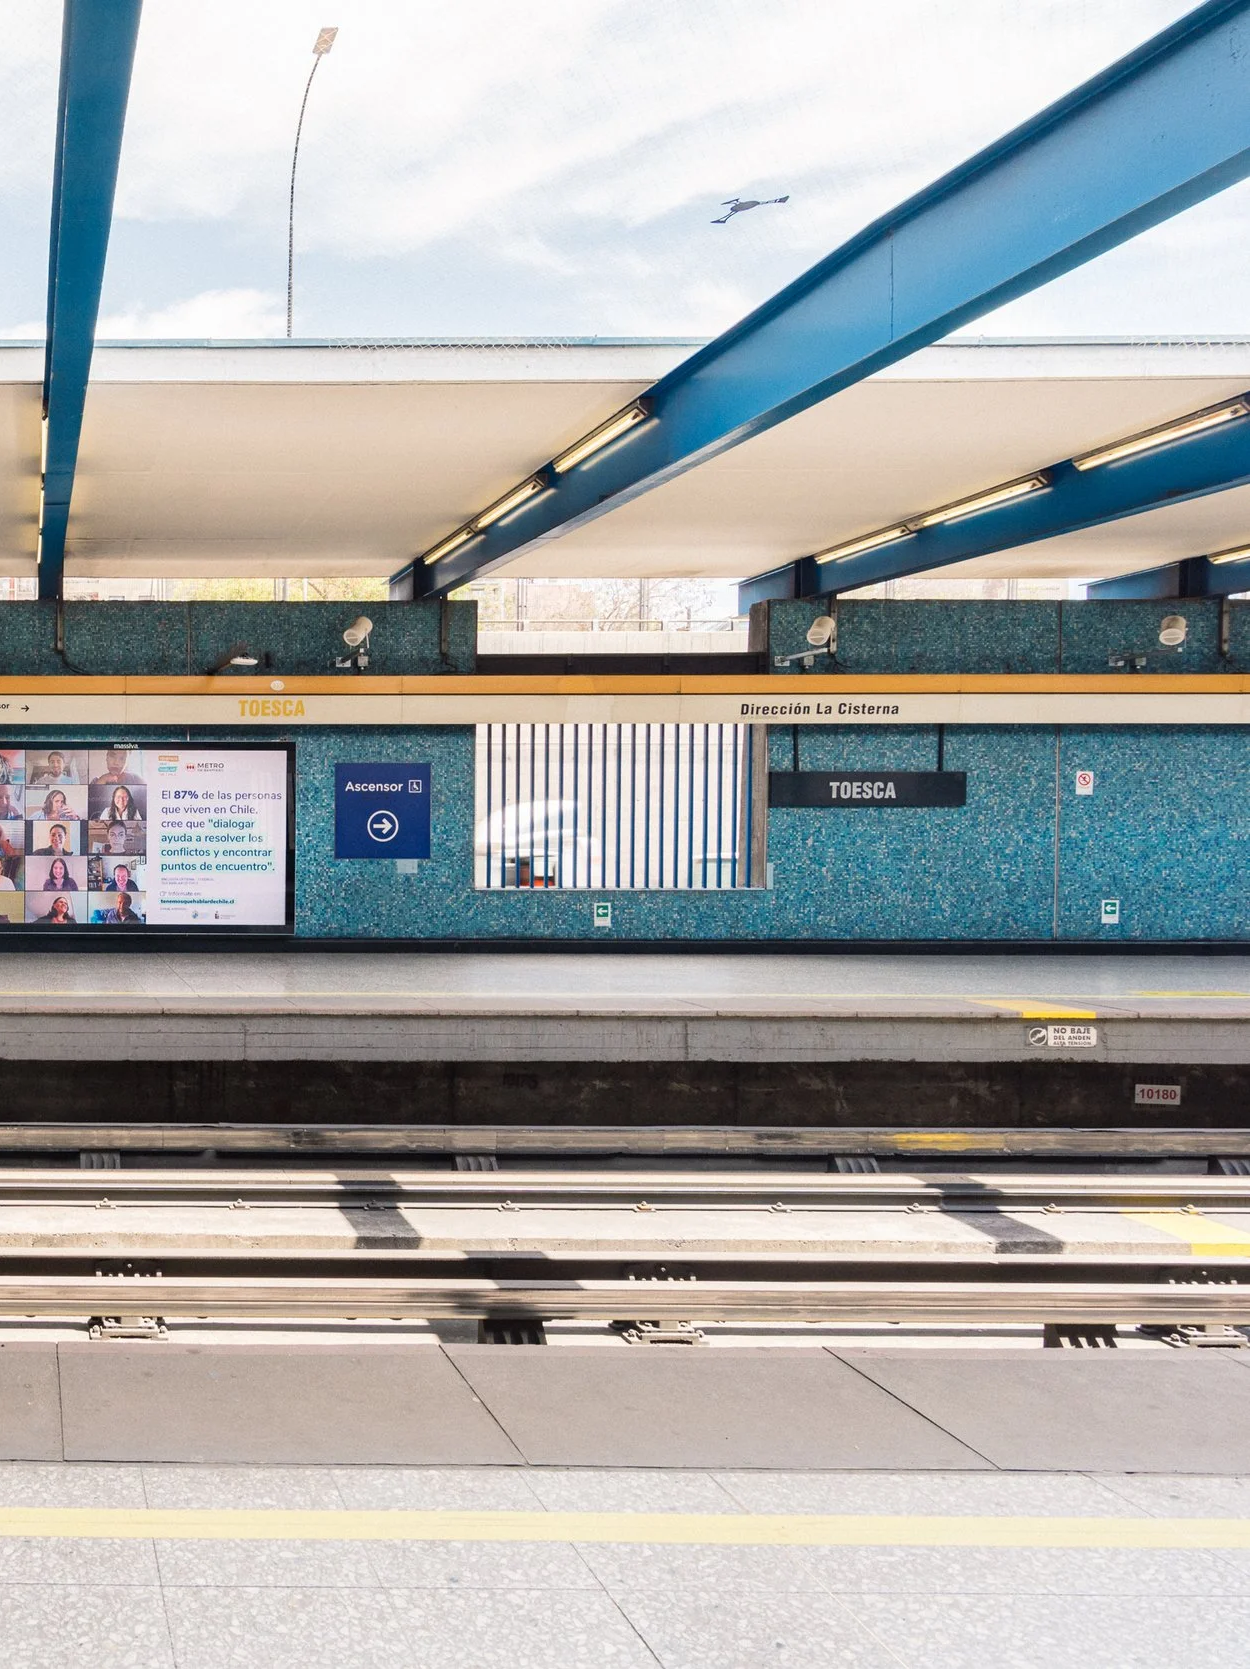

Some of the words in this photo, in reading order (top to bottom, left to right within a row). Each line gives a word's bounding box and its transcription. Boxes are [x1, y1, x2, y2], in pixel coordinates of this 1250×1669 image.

[238, 699, 306, 717] TOESCA
[740, 702, 811, 715] Dirección
[816, 702, 832, 715] La
[838, 702, 899, 715] Cisterna
[344, 780, 404, 793] Ascensor
[829, 781, 896, 799] TOESCA
[161, 790, 171, 800] El
[173, 790, 199, 800] 87%
[201, 790, 215, 800] de
[217, 790, 232, 800] las
[234, 792, 282, 803] personas
[161, 806, 181, 817] que
[183, 804, 211, 814] viven
[213, 806, 227, 814] en
[161, 820, 183, 828] cree
[185, 820, 206, 831] que
[208, 819, 255, 831] "dialogar
[161, 833, 193, 845] ayuda
[195, 835, 202, 843] a
[204, 833, 246, 843] resolver
[248, 833, 263, 843] los
[161, 847, 211, 857] conflictos
[213, 850, 220, 858] y
[222, 849, 273, 857] encontrar
[161, 862, 197, 872] puntos
[199, 861, 213, 871] de
[215, 861, 276, 871] encuentro".
[1053, 1027, 1067, 1035] NO
[1070, 1027, 1091, 1035] BAJE
[1139, 1088, 1177, 1100] 10180
